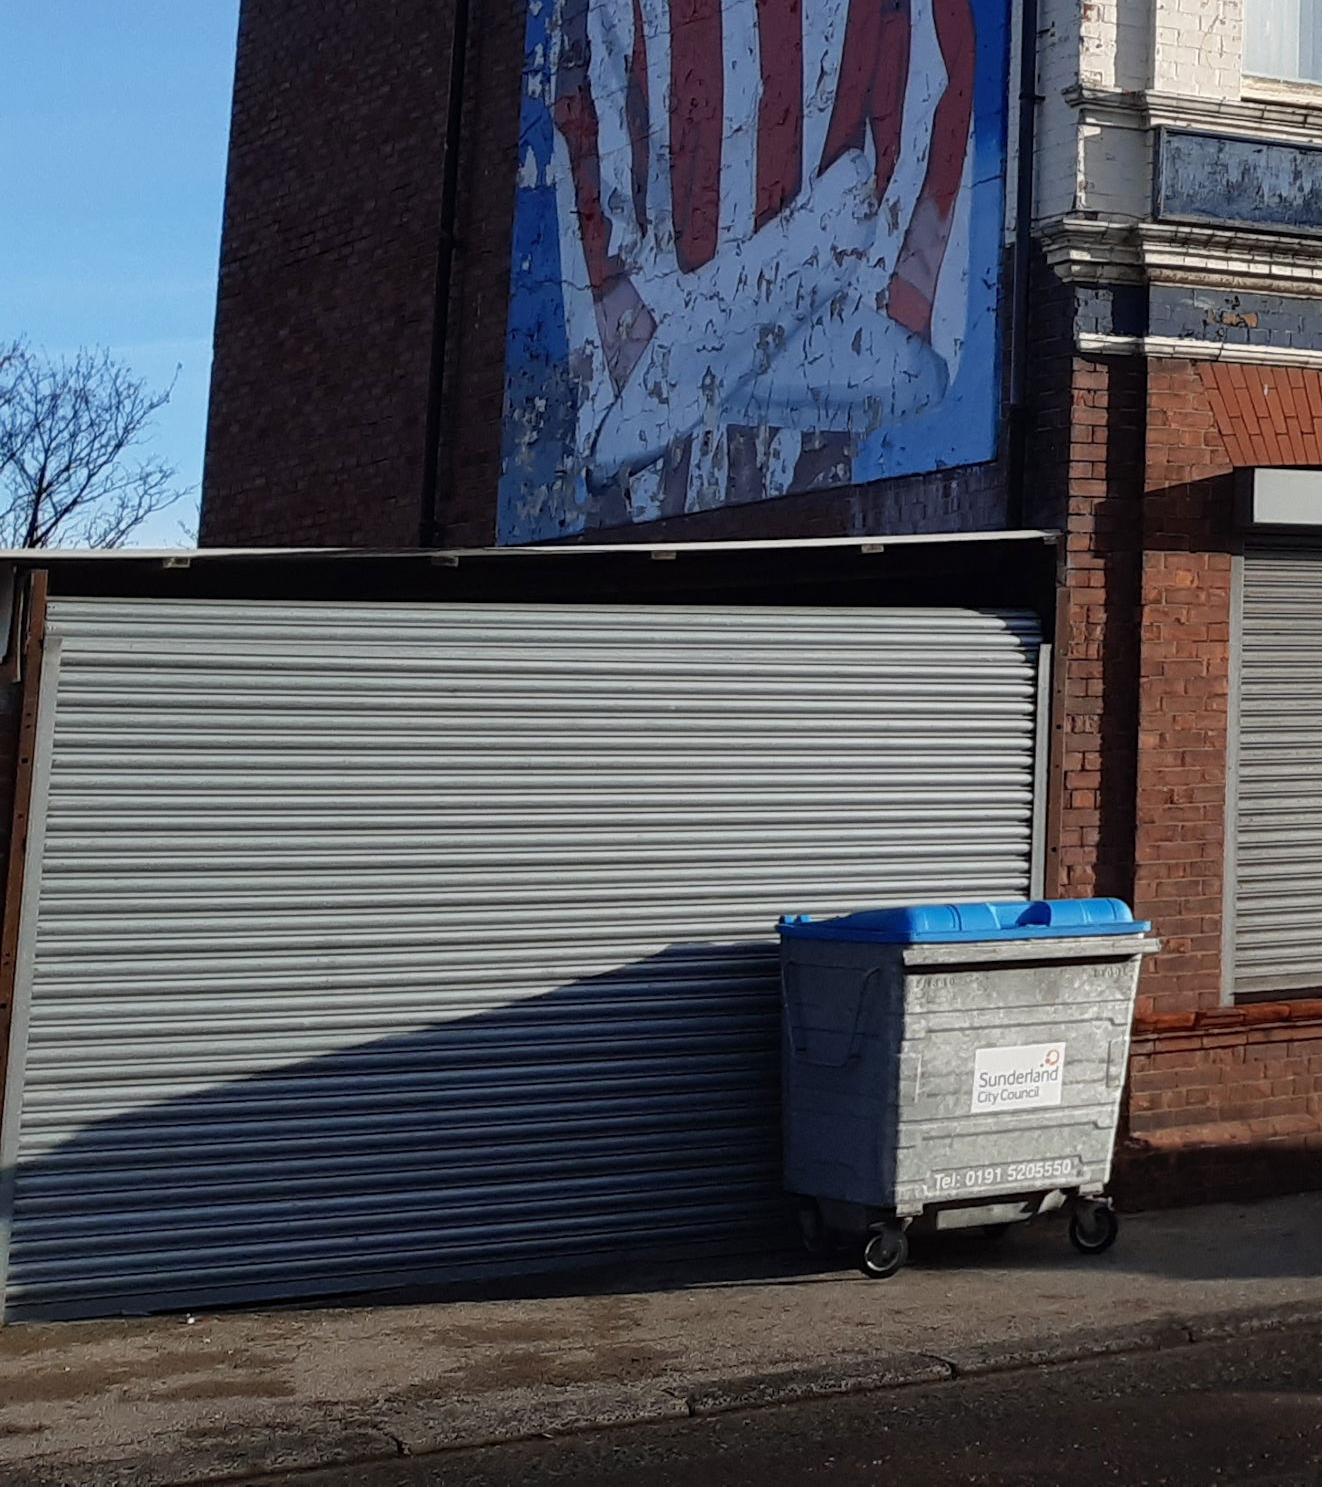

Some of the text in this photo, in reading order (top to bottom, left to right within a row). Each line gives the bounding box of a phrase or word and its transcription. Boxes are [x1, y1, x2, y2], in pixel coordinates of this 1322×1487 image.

[978, 1066, 1060, 1089] Sunderland
[977, 1086, 1040, 1106] City Council
[934, 1159, 1072, 1191] Tel: 0191 5205550
